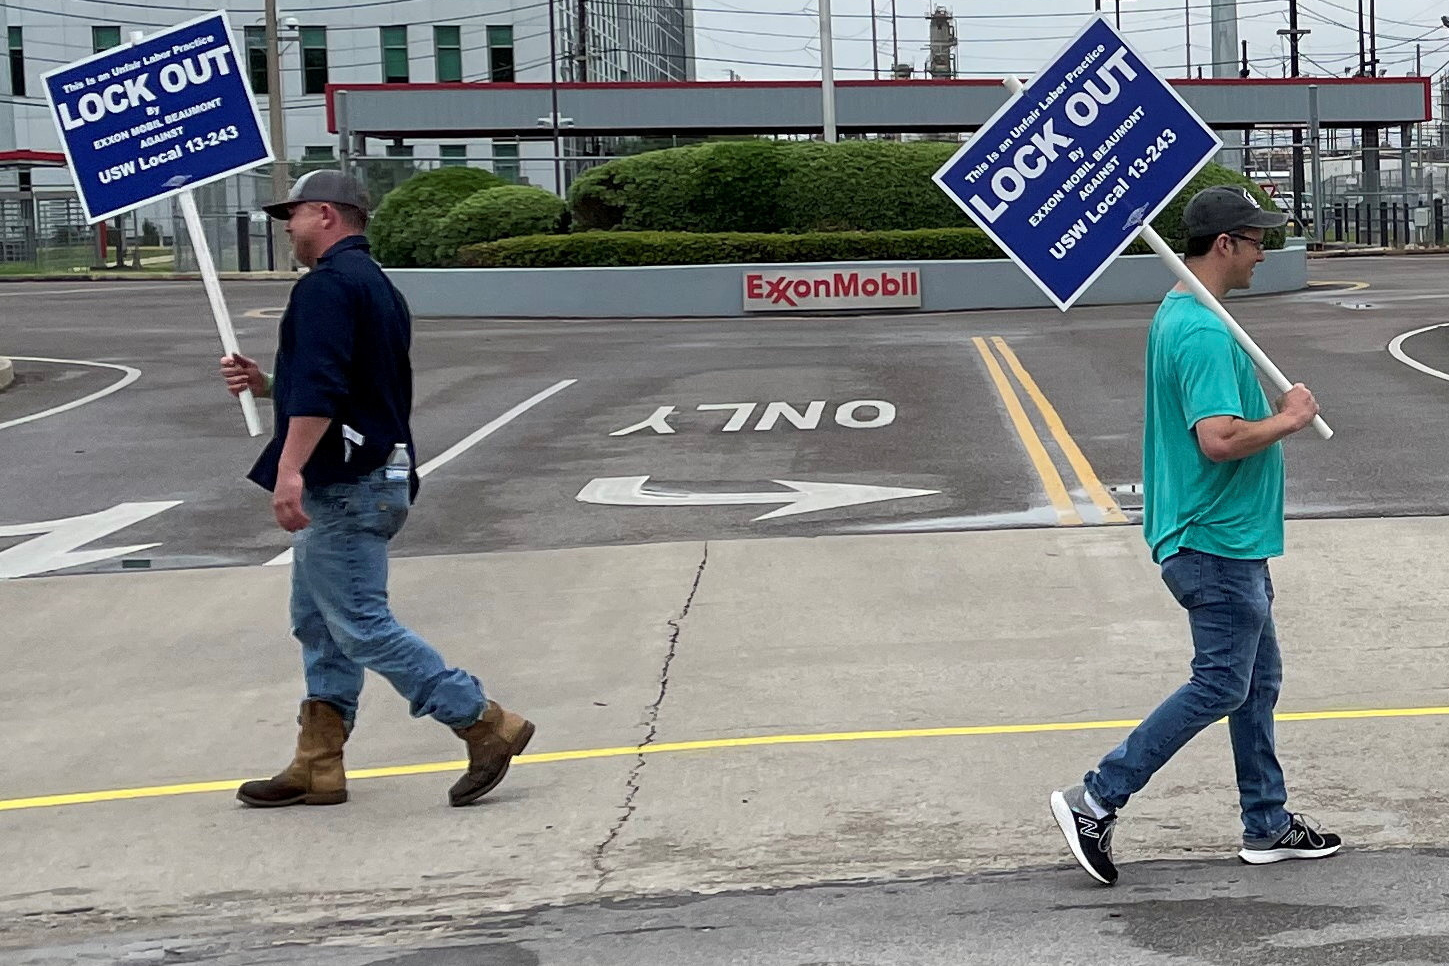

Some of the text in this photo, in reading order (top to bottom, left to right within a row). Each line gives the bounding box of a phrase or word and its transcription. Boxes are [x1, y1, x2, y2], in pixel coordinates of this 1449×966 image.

[57, 44, 231, 131] LOCK OUT
[62, 82, 85, 94] This
[97, 73, 111, 82] an
[111, 61, 141, 76] Unfair
[143, 50, 171, 66] Labor
[172, 35, 214, 55] Practice
[93, 97, 221, 150] EXXON MOBIL BEAUMONT
[140, 126, 183, 149] AGAINST
[146, 106, 160, 116] By
[965, 162, 989, 183] This
[999, 138, 1013, 152] an
[1010, 108, 1040, 138] Unfair
[1038, 81, 1067, 110] Labor
[1065, 45, 1105, 83] Practice
[969, 46, 1138, 224] LOCK OUT
[98, 125, 239, 184] USW Local 13-243
[1028, 106, 1145, 227] EXXON MOBIL BEAUMONT
[1068, 147, 1084, 162] By
[1079, 155, 1120, 201] AGAINST
[1049, 129, 1176, 259] USW Local 13-243
[746, 271, 918, 307] ExxonMobil
[608, 398, 897, 436] ONLY
